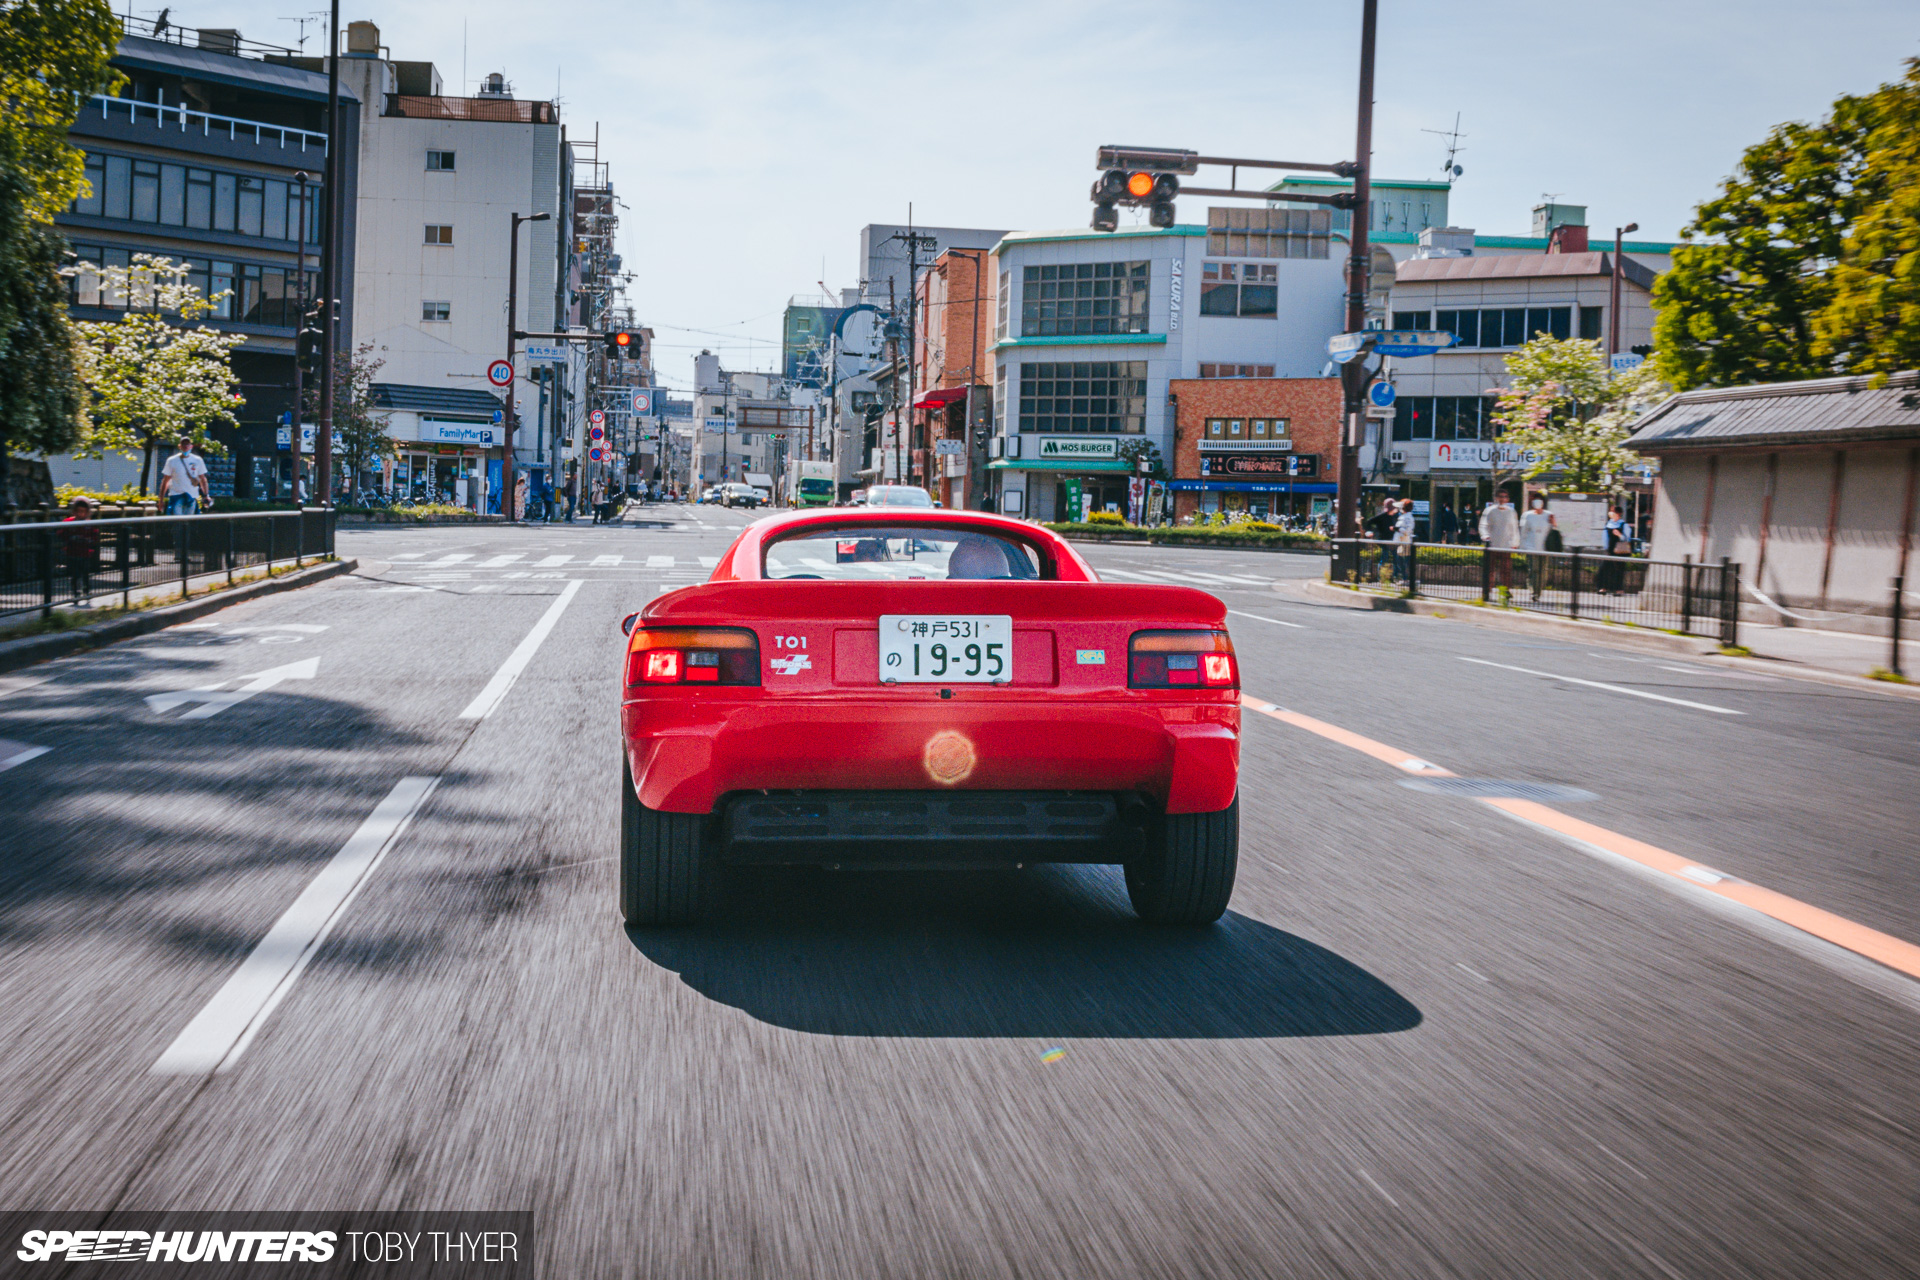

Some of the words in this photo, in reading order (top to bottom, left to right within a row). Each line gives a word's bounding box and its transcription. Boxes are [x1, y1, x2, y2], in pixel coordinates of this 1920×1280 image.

[1170, 257, 1182, 311] SAKURA
[1170, 311, 1178, 332] BLD.
[528, 347, 566, 356] 烏丸今出川
[493, 367, 509, 379] 40
[637, 399, 647, 407] 40
[439, 427, 481, 440] FamilyMar
[482, 431, 491, 442] P
[1060, 444, 1079, 452] MOS
[1081, 444, 1112, 452] BURGER
[1290, 457, 1297, 469] P
[886, 652, 902, 667] の
[913, 643, 1004, 676] 19-95
